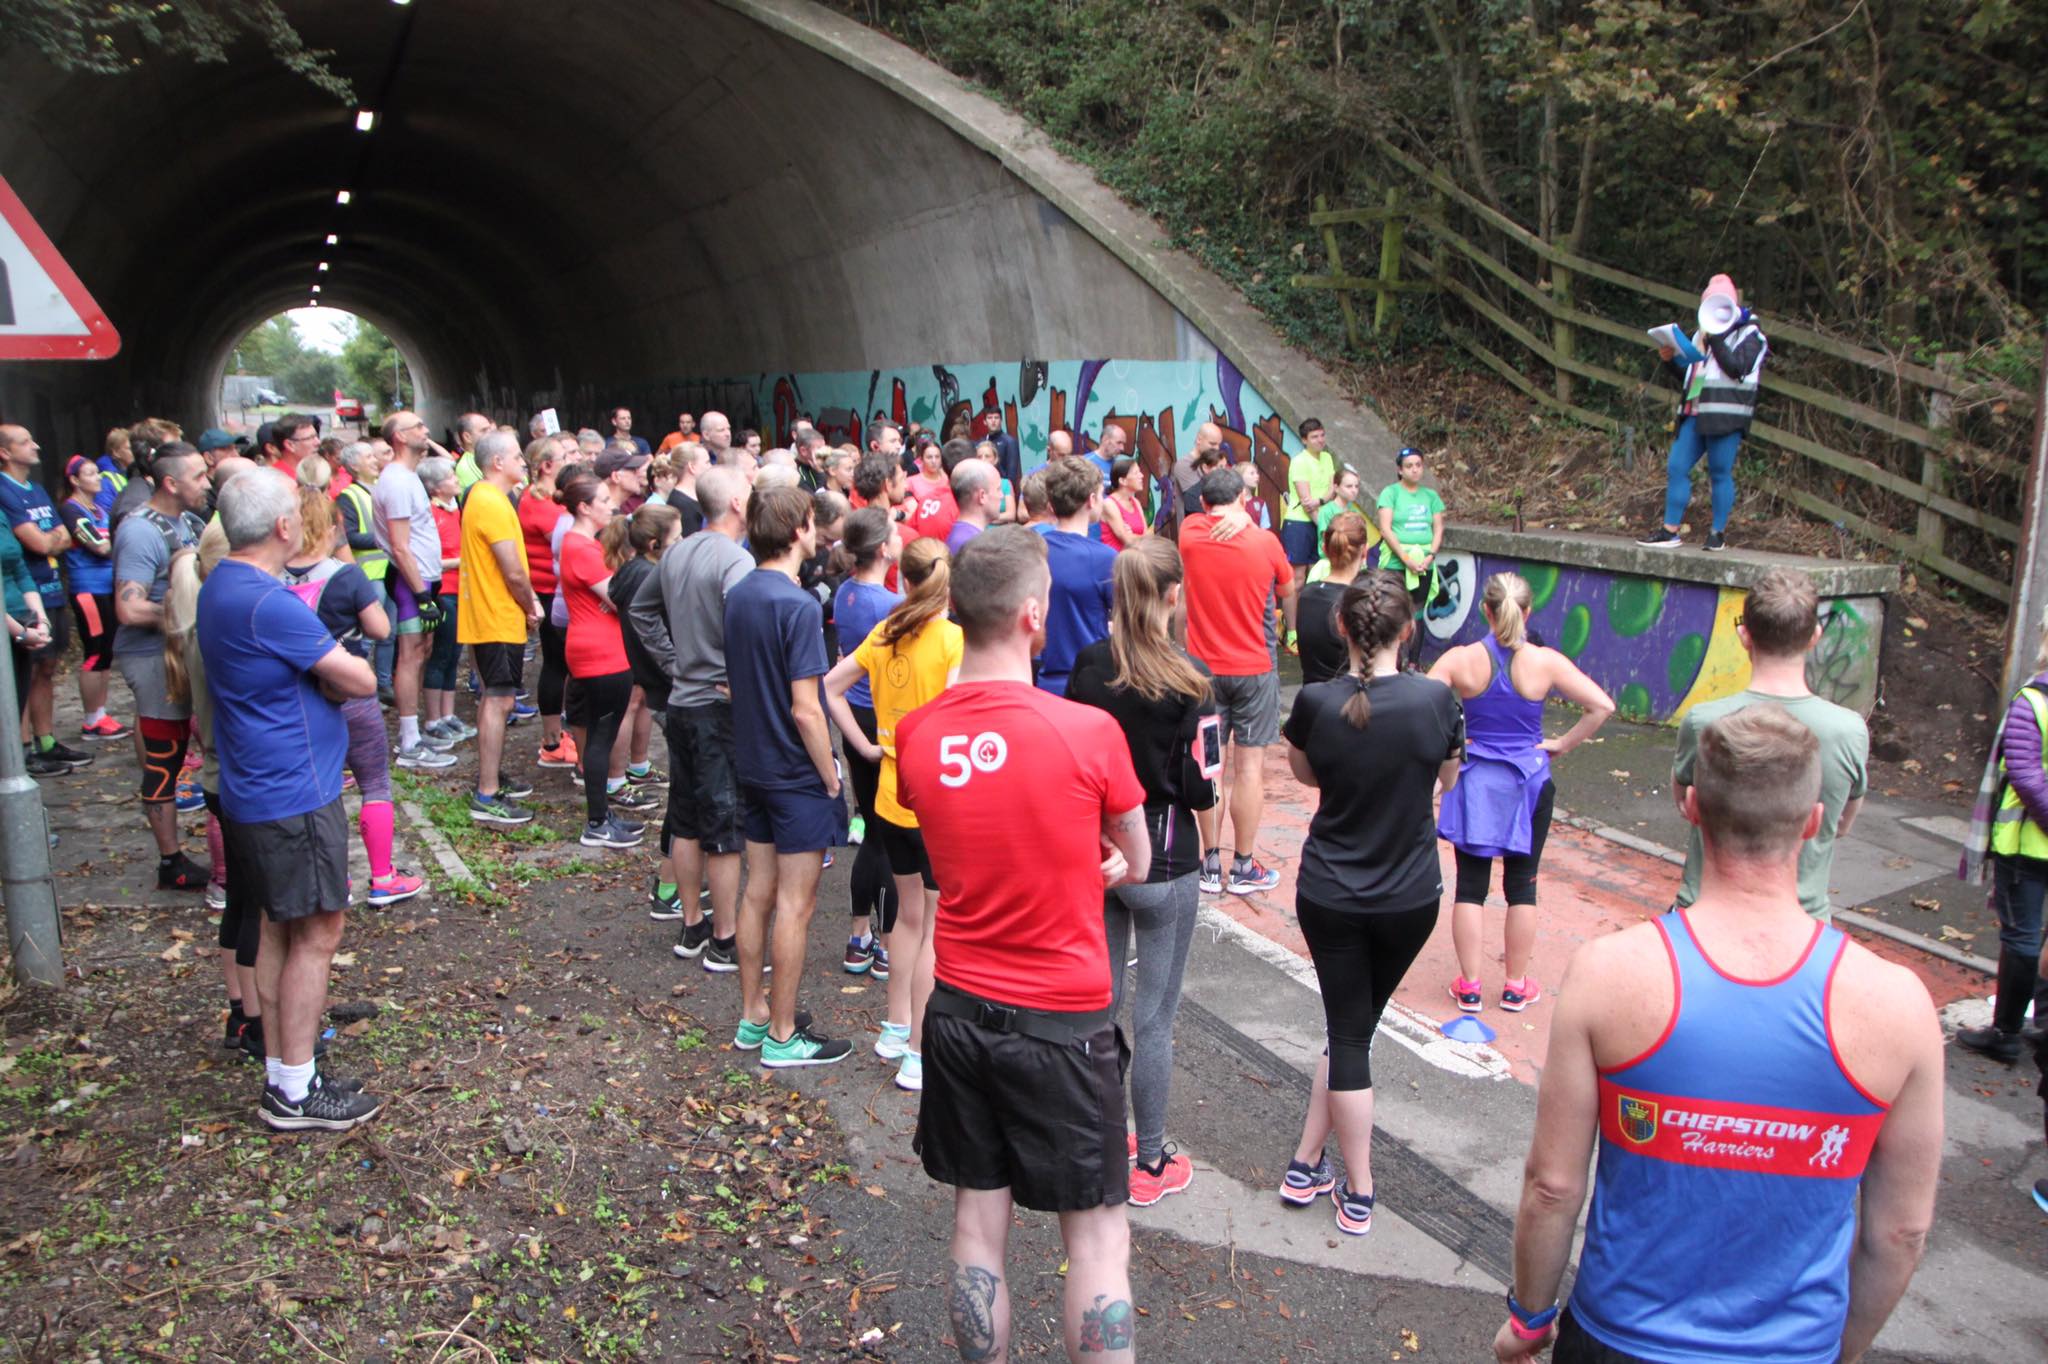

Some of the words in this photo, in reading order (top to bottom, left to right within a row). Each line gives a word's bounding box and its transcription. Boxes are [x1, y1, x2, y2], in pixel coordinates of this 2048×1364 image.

[920, 499, 941, 518] 50
[940, 731, 1008, 787] 50
[1662, 1109, 1816, 1141] CHEPSTOW
[1680, 1131, 1776, 1159] Harriers
